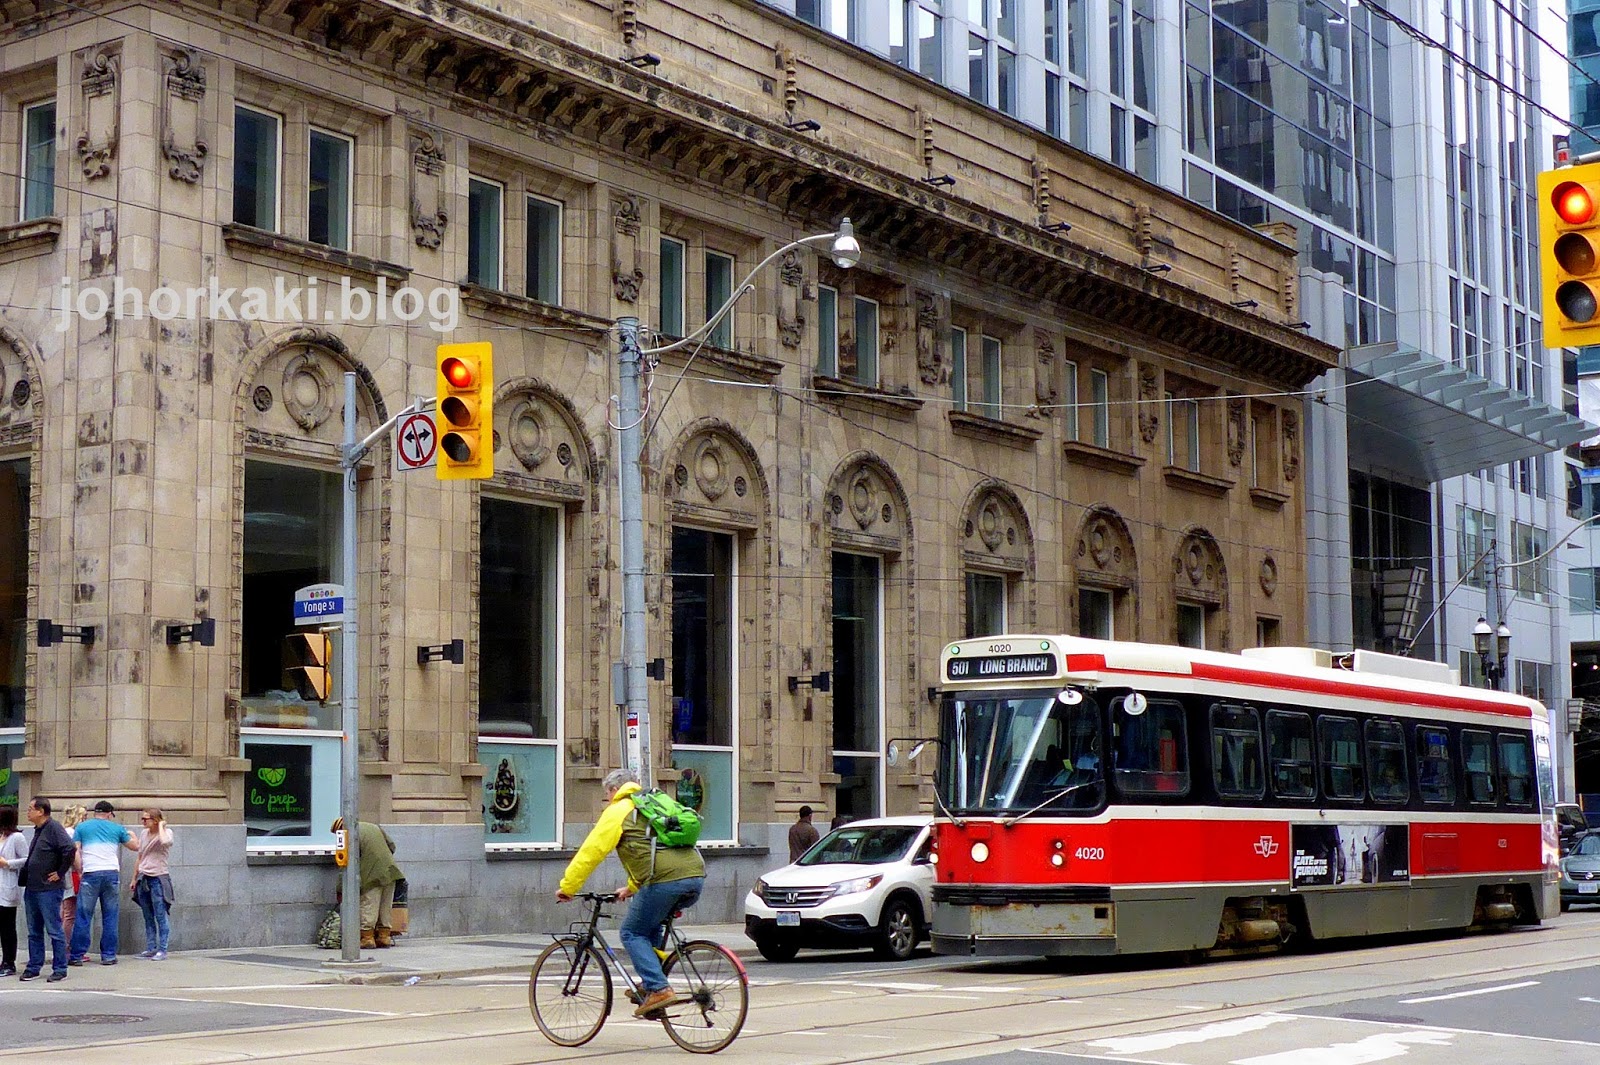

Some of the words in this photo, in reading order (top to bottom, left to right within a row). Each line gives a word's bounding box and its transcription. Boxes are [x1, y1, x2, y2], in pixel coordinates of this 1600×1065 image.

[303, 601, 327, 614] Yonge
[328, 601, 335, 610] St
[988, 644, 1012, 653] 4020
[952, 661, 969, 675] 501
[980, 659, 1005, 674] LONG
[1007, 657, 1048, 673] BRANCH
[251, 788, 265, 804] la
[268, 794, 297, 812] prep
[1075, 847, 1104, 860] 4020
[1293, 855, 1315, 868] FATE
[1295, 866, 1328, 879] FURIOUS
